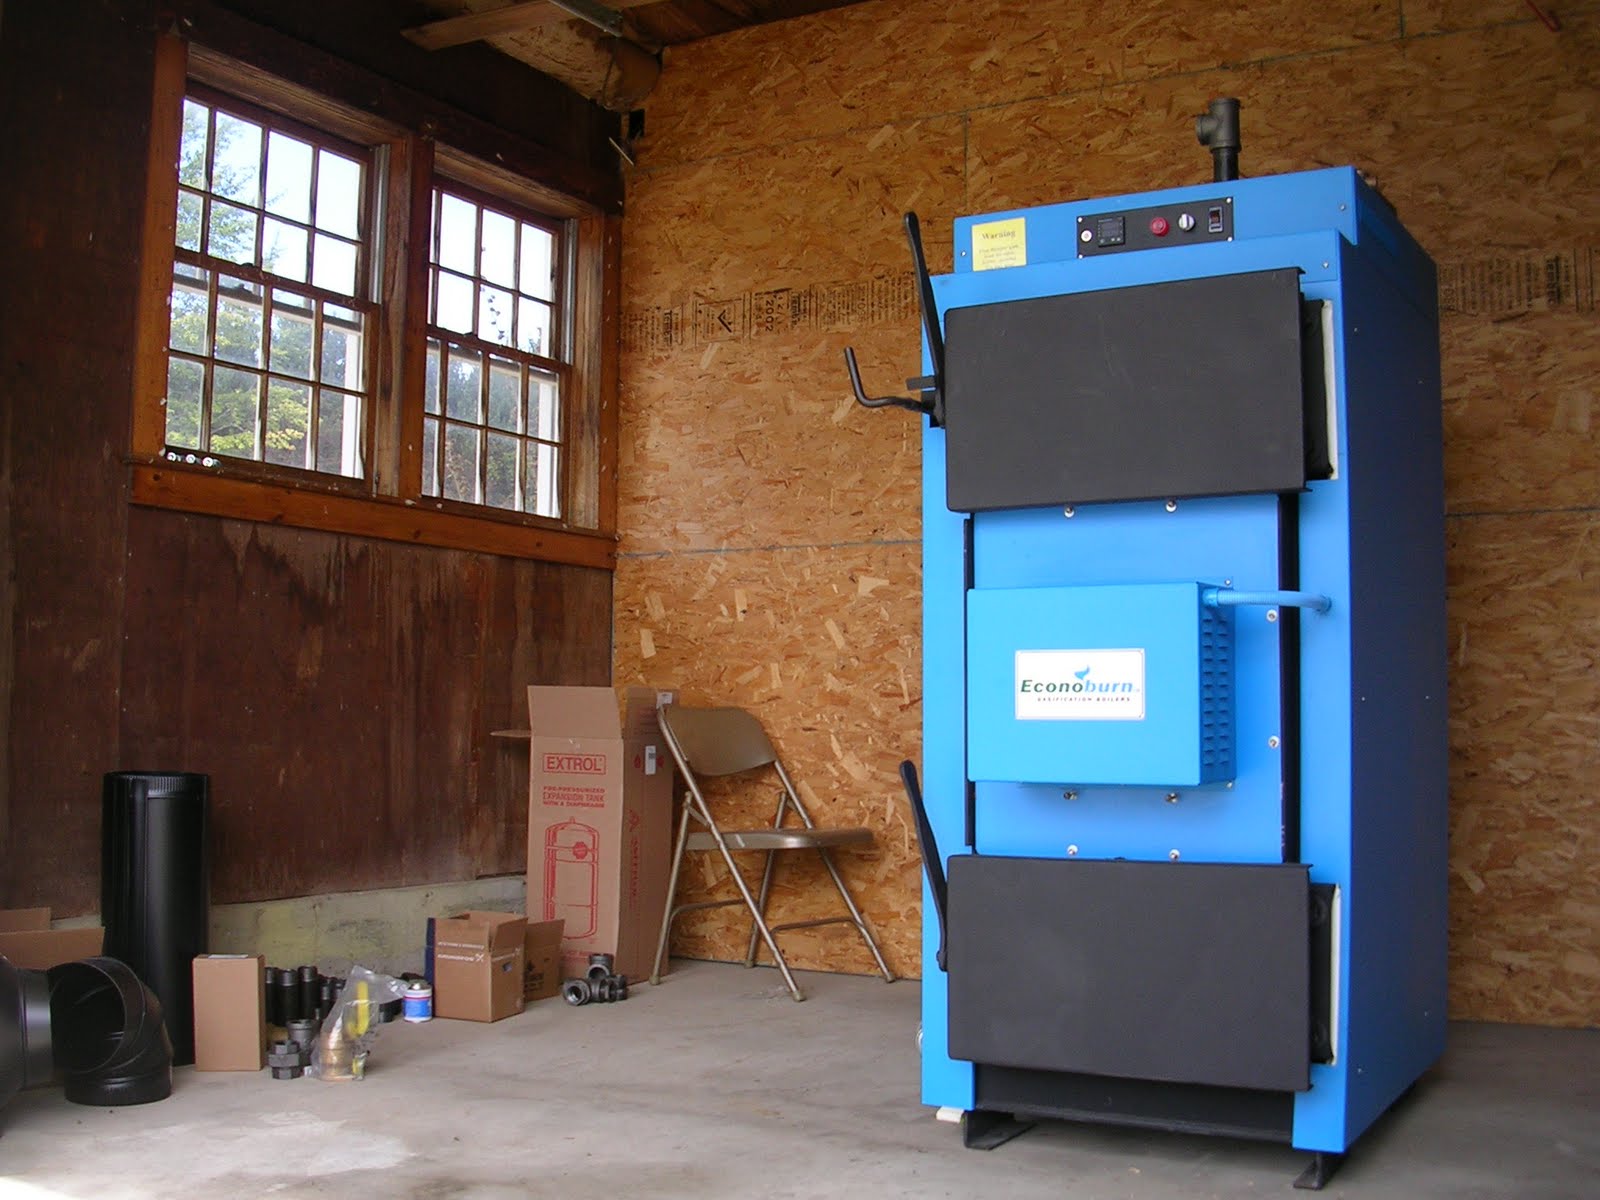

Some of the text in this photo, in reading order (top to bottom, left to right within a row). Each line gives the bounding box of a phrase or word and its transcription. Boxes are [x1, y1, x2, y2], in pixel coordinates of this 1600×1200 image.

[981, 230, 1017, 240] Warning
[766, 299, 775, 332] 2002
[1020, 679, 1133, 693] Econoburn
[546, 756, 601, 771] EXTROL
[586, 794, 605, 802] TANK
